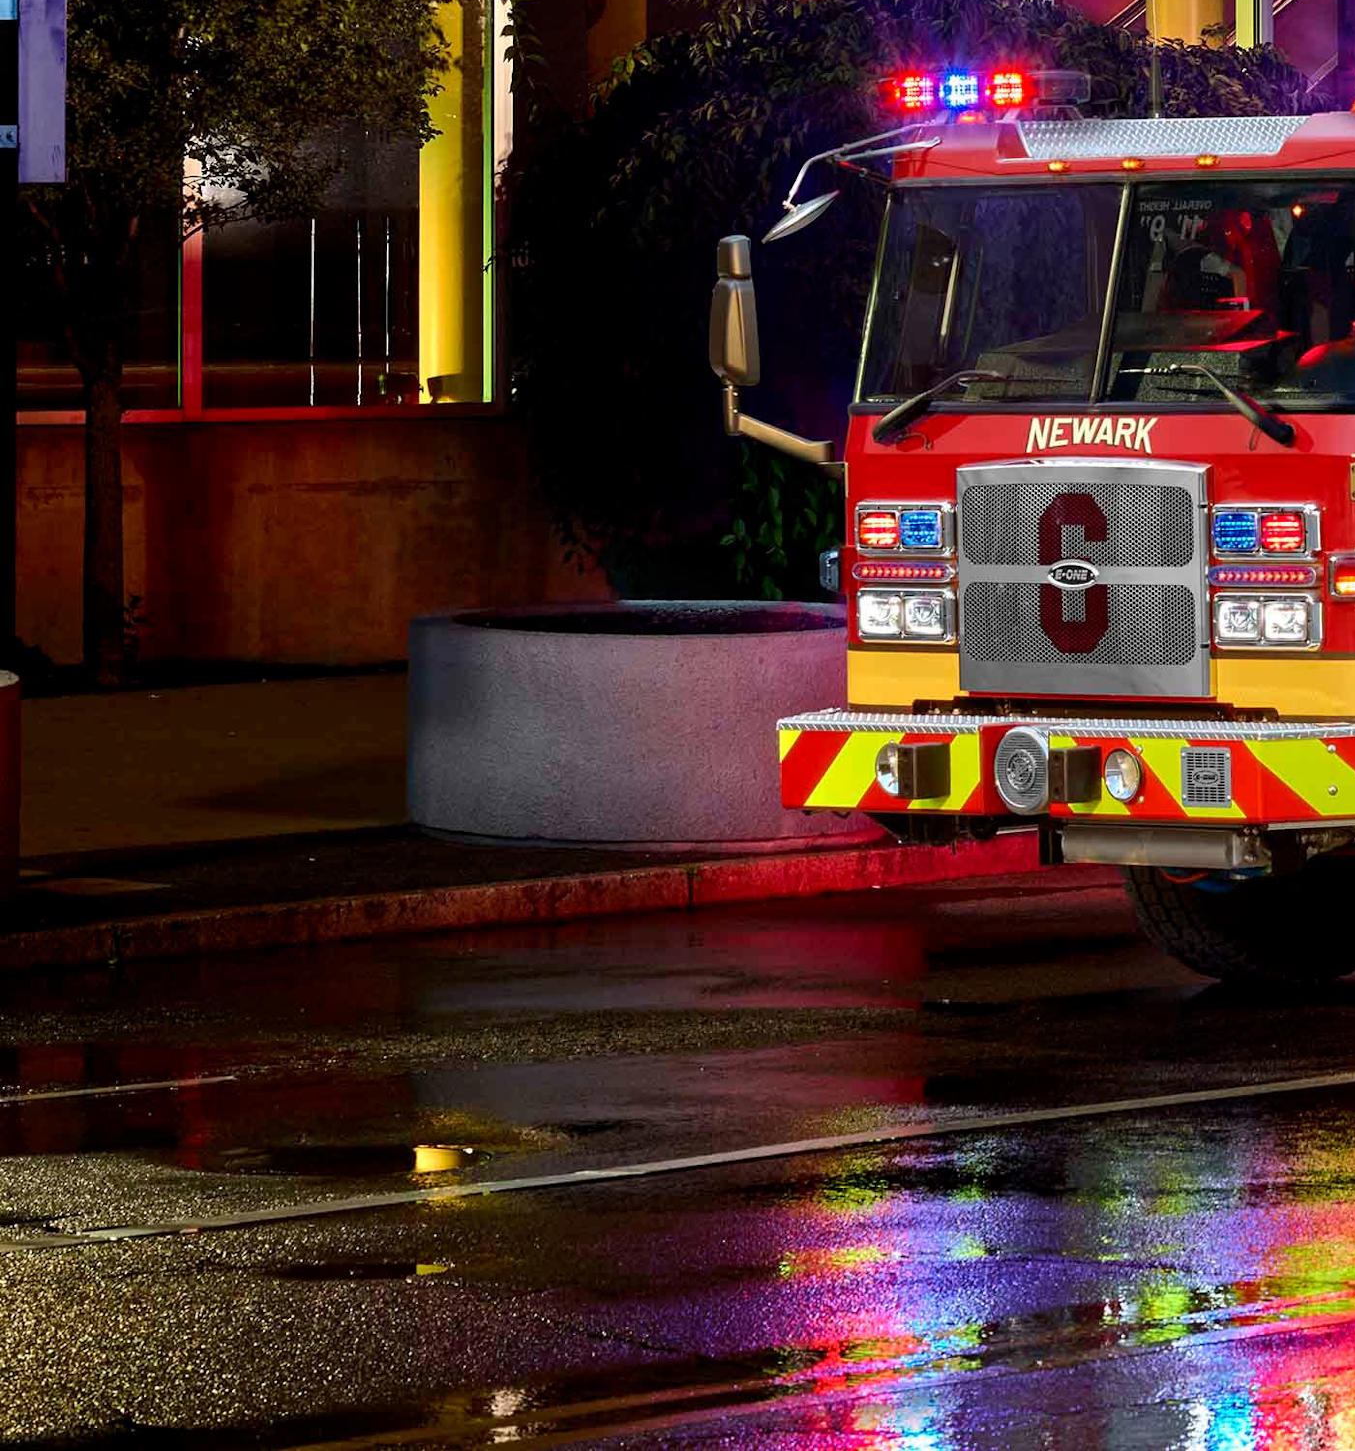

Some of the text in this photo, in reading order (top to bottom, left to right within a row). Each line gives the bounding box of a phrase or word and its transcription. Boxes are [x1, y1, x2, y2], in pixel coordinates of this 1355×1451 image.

[1026, 417, 1158, 454] NEWARK
[1038, 493, 1109, 654] 6
[1055, 568, 1088, 580] E-ONE
